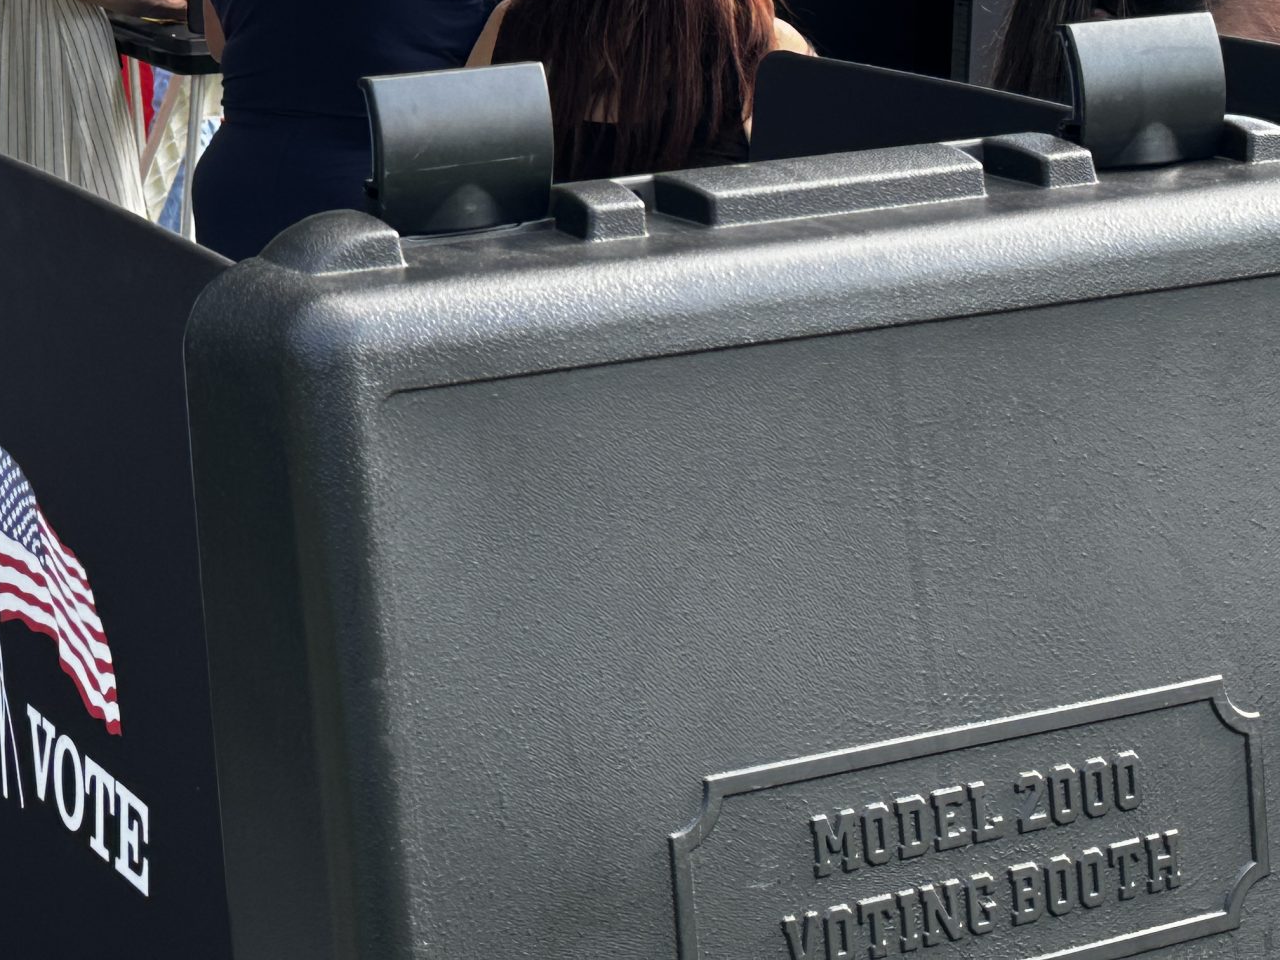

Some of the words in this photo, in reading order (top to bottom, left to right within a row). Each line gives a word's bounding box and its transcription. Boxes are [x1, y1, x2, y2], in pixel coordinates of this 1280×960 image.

[26, 702, 150, 898] VOTE
[809, 780, 1004, 879] MODEL
[1014, 749, 1144, 835] 2000
[780, 871, 998, 960] VOTING
[1007, 828, 1181, 928] BOOTH
